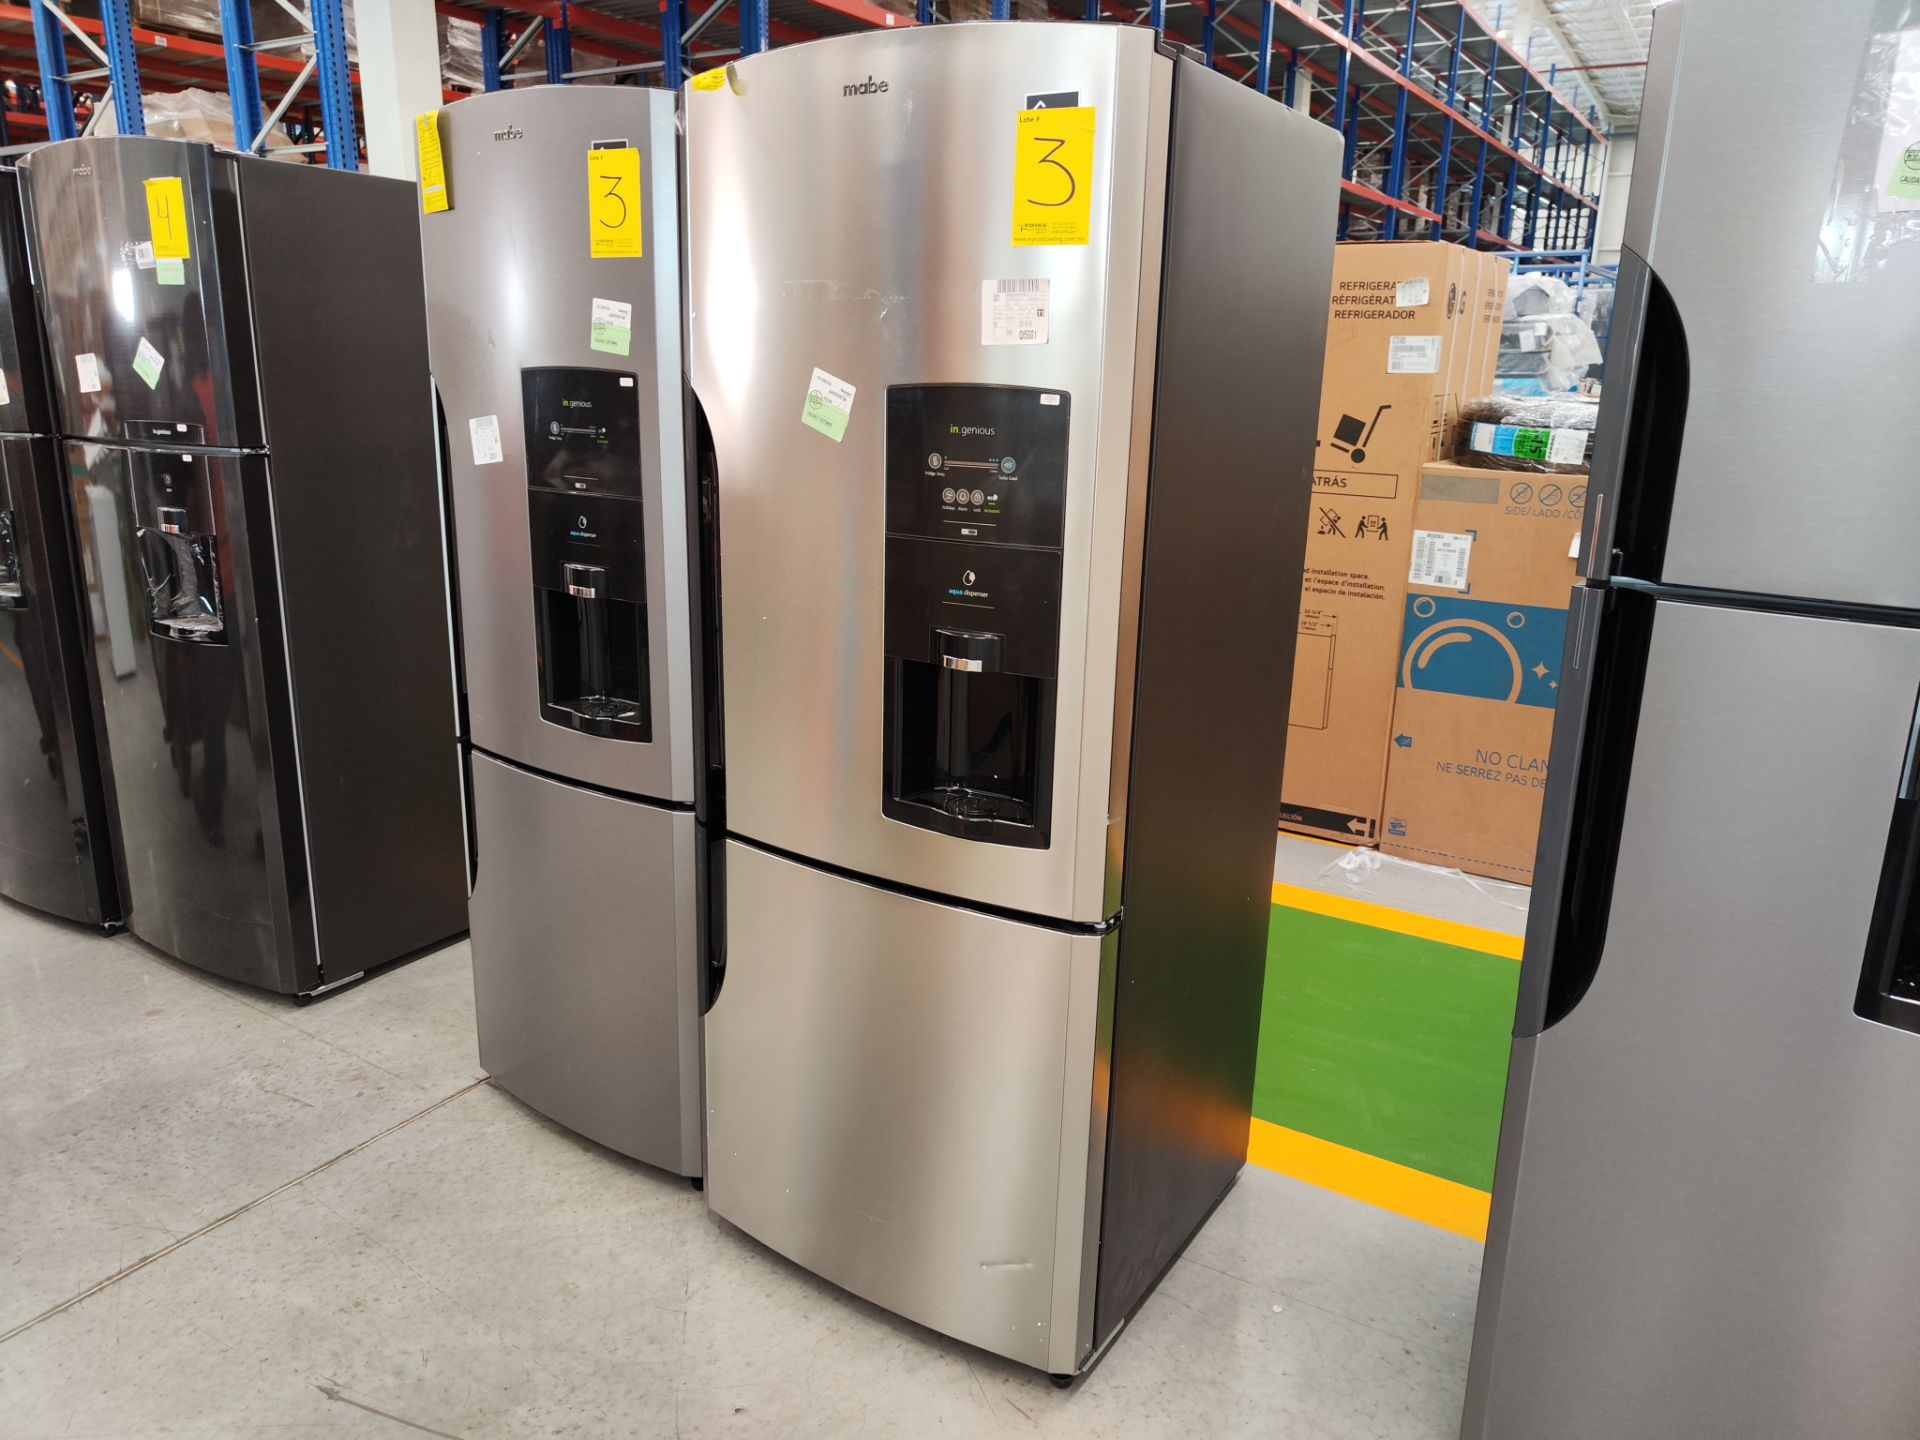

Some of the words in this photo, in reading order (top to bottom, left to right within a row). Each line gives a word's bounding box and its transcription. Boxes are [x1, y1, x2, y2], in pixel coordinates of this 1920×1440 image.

[843, 75, 889, 97] mabe
[1019, 116, 1034, 124] Lote
[494, 124, 523, 141] mabe
[72, 163, 92, 176] mabe
[1027, 136, 1076, 207] 3
[599, 175, 627, 229] 3
[155, 195, 173, 241] 4
[1340, 281, 1402, 291] REFRIGERA
[1334, 309, 1416, 320] REFRIGERADOR
[949, 423, 996, 437] in.genious
[1533, 508, 1560, 518] LADO
[1311, 567, 1348, 578] installation
[1312, 587, 1337, 596] espacio
[1475, 749, 1502, 766] NO
[1436, 760, 1453, 773] NE
[1455, 764, 1502, 781] SERREZ
[1505, 772, 1528, 786] PAS
